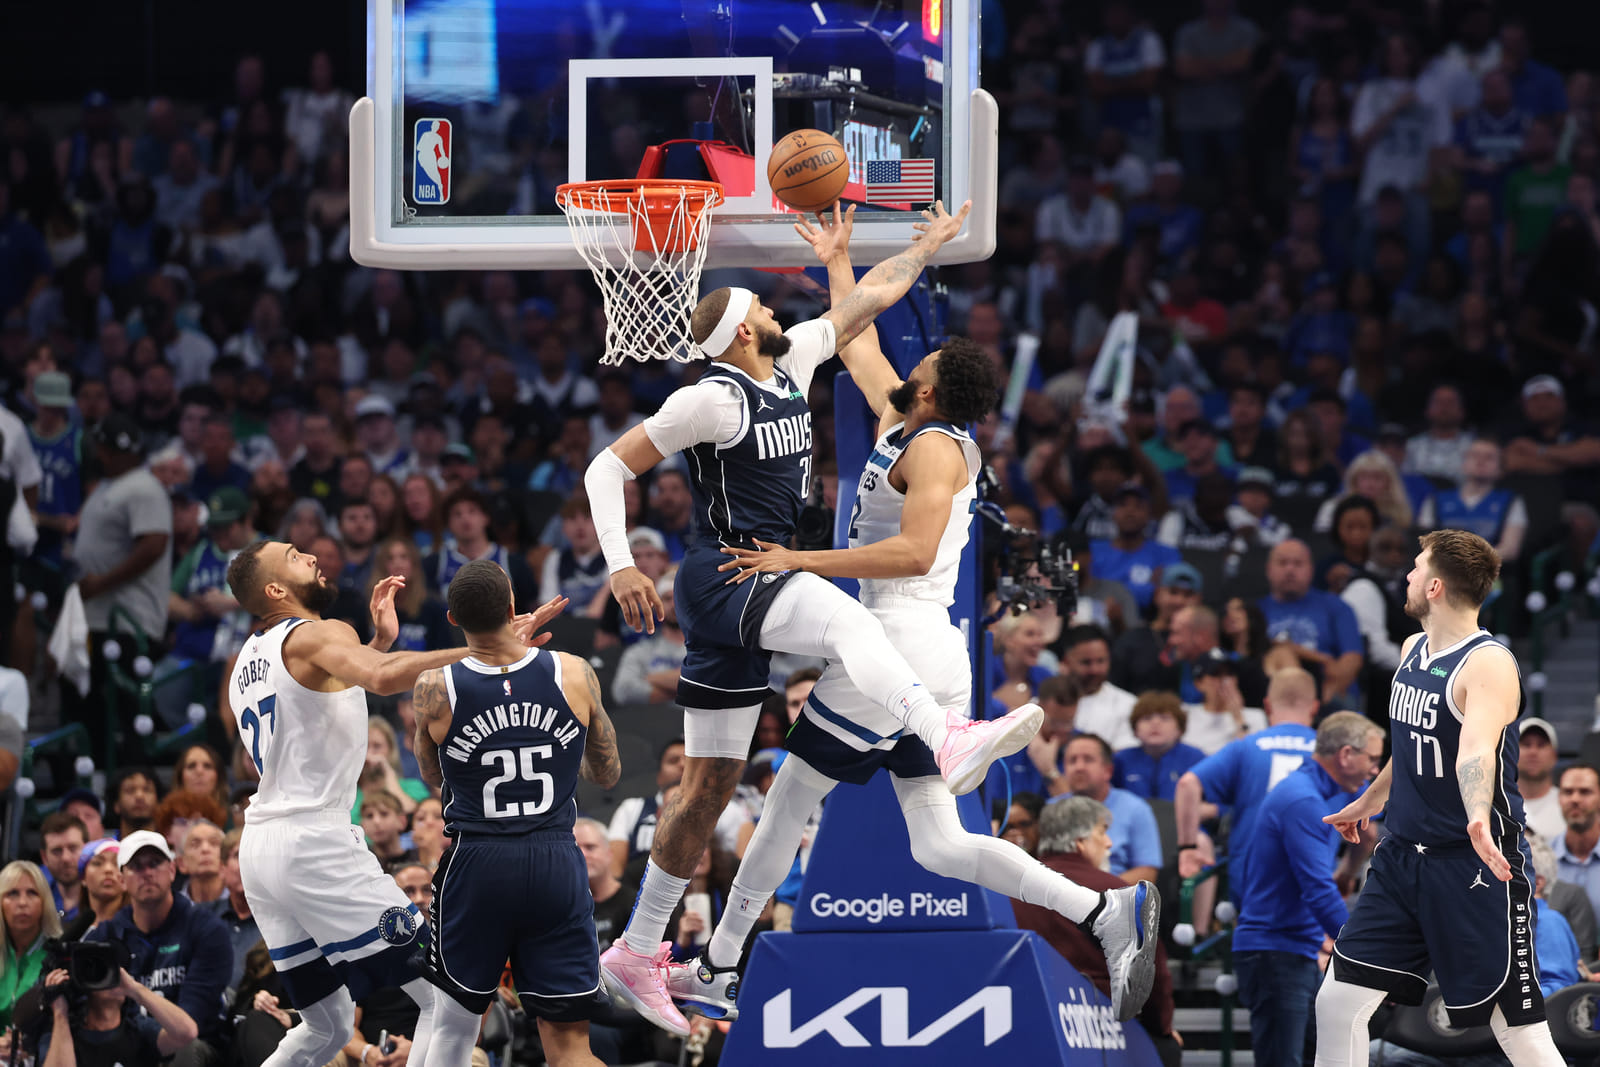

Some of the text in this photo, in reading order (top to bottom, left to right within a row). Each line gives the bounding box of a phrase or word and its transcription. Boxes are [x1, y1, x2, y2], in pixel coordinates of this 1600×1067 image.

[784, 150, 838, 178] Wilson
[418, 184, 437, 199] NBA
[237, 658, 271, 695] GOBERT
[1388, 680, 1441, 731] MAVS
[240, 693, 277, 777] 27
[446, 702, 580, 763] WASHINGTON JR.
[1409, 730, 1445, 778] 77
[480, 744, 555, 819] 25
[810, 892, 968, 924] Google Pixel
[1058, 986, 1127, 1050] coinbase
